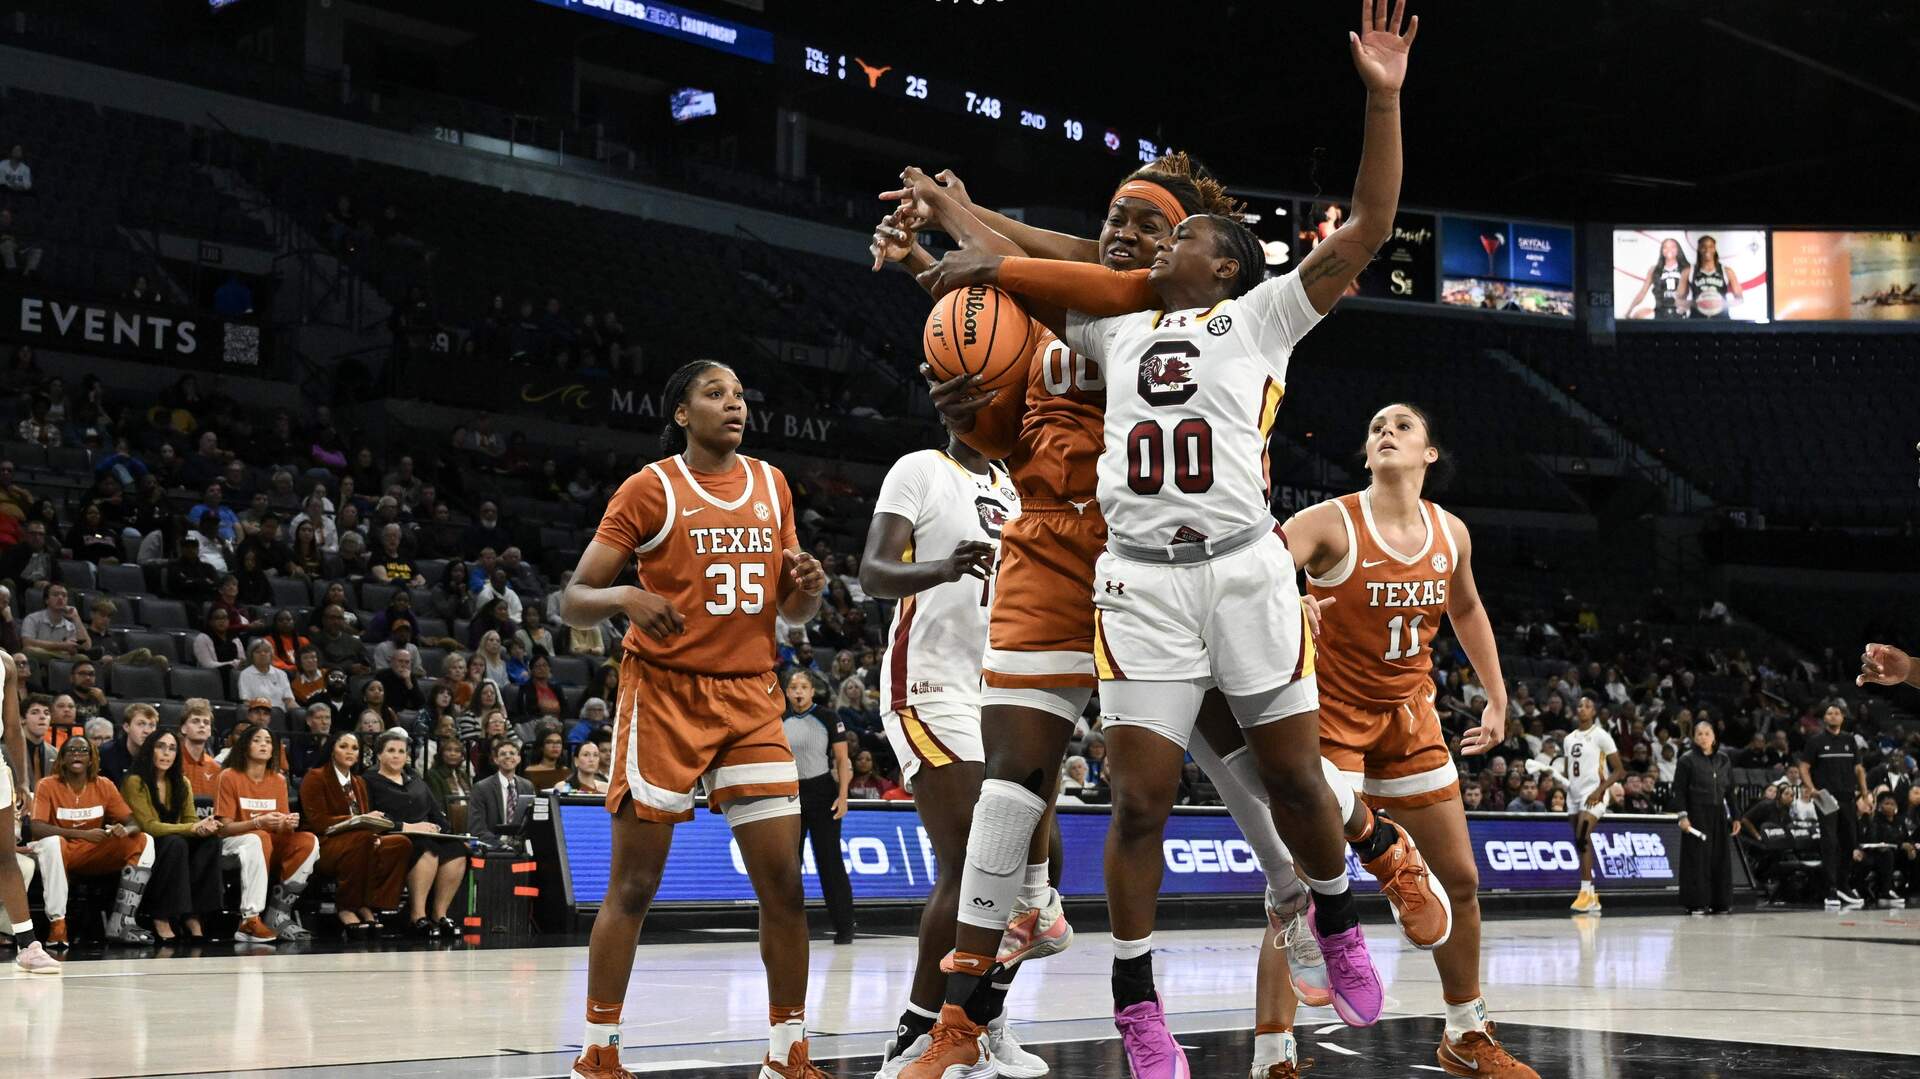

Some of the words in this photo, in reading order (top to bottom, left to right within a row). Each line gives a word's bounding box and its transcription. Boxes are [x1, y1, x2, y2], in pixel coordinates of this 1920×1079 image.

[570, 0, 646, 20] AYERS
[646, 6, 680, 29] ERA
[681, 16, 737, 44] CHAMPIONSHIP
[805, 47, 829, 64] TOL:
[805, 59, 829, 75] FLS:
[906, 75, 928, 99] 25
[965, 91, 1001, 119] 7:48
[1020, 111, 1046, 129] 2ND
[1064, 119, 1084, 141] 19
[20, 297, 198, 354] EVENTS
[1209, 317, 1230, 334] SEC
[784, 413, 832, 442] BAY
[1127, 417, 1214, 496] 00
[689, 527, 773, 555] TEXAS
[705, 563, 765, 615] 35
[1366, 579, 1446, 608] TEXAS
[1384, 614, 1424, 661] 11
[910, 682, 918, 695] 4
[919, 686, 944, 694] CULTURE
[1573, 761, 1580, 777] 8
[1163, 839, 1263, 873] GEIC
[1485, 840, 1580, 870] GEICO
[1590, 831, 1666, 857] PLAYERS
[1604, 855, 1638, 876] ERA
